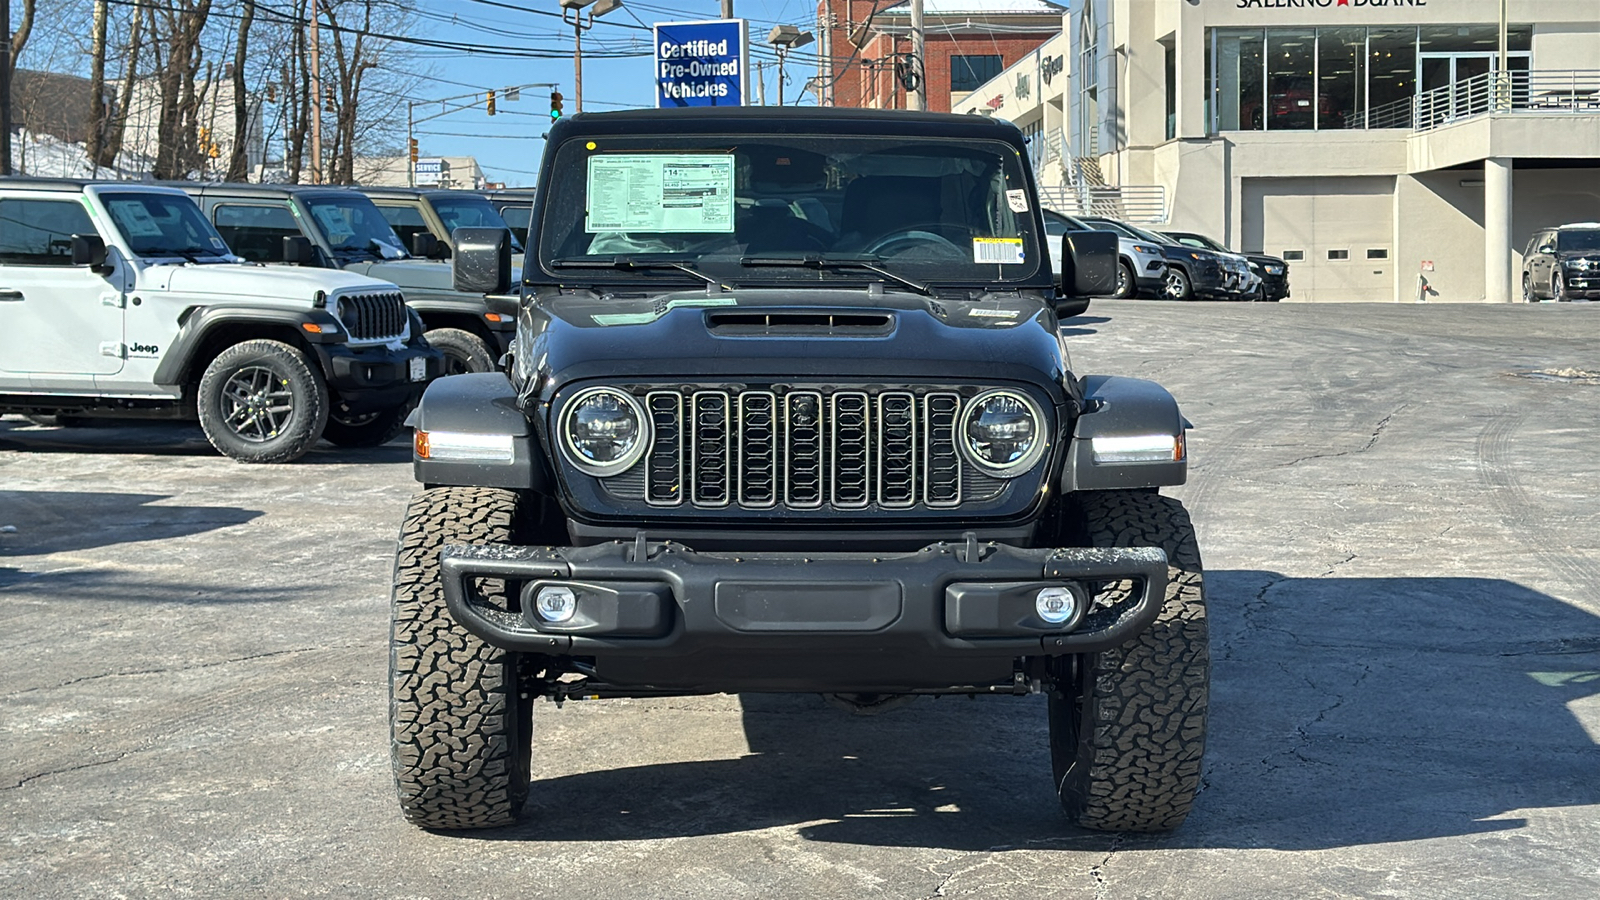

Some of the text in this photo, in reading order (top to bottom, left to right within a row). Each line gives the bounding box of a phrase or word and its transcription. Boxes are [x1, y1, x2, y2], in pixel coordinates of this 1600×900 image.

[660, 39, 727, 58] Certified
[661, 59, 737, 78] Pre-Owned
[662, 81, 728, 98] Vehicles
[130, 342, 158, 354] Jeep
